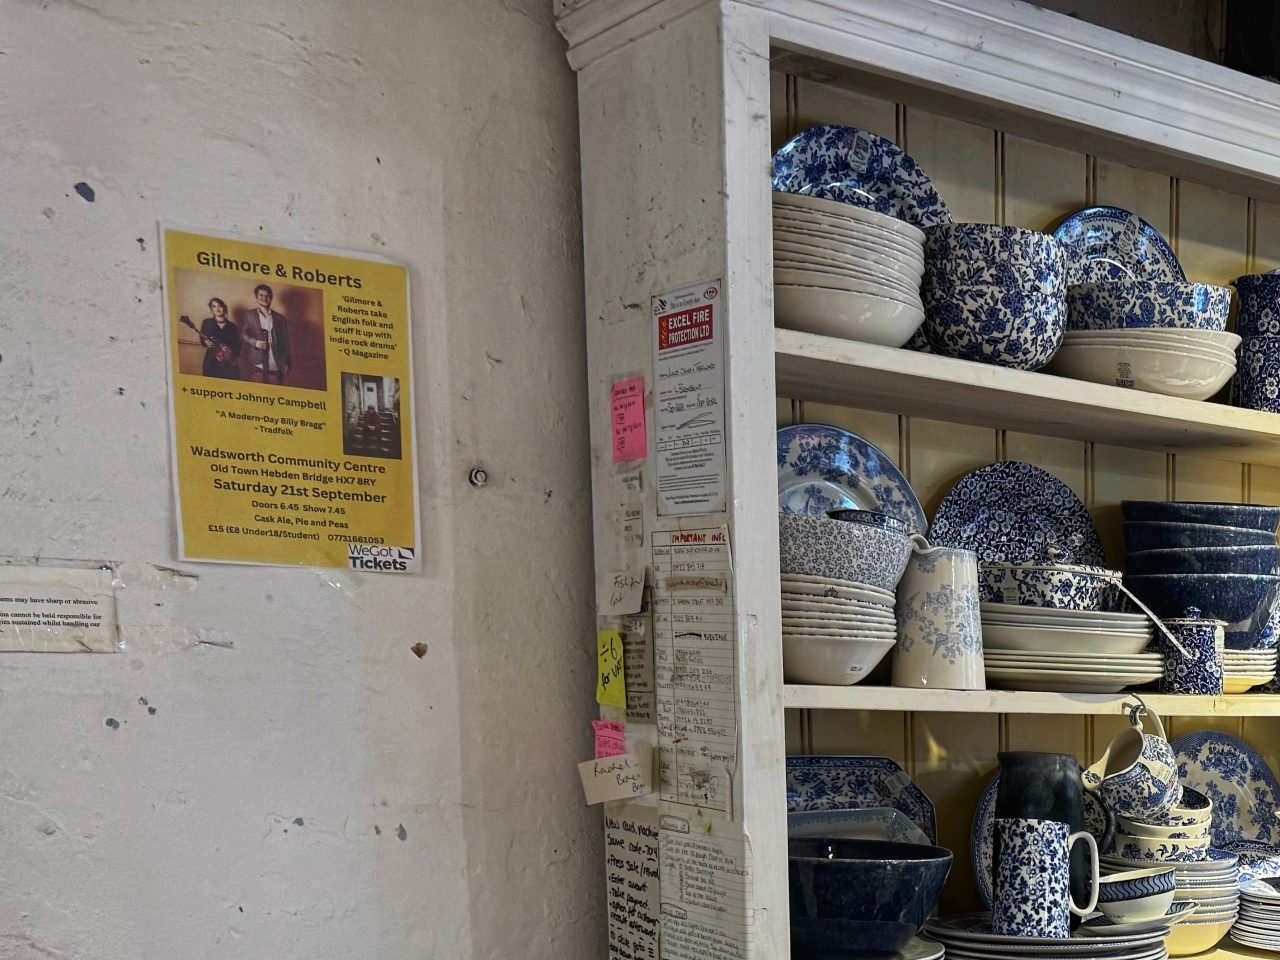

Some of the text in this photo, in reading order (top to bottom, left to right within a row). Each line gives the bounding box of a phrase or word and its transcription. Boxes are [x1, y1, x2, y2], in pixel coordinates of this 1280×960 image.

[197, 251, 362, 289] Gilmore & Roberts
[337, 305, 388, 318] Roberts take
[668, 309, 710, 329] EXCEL FIRE
[332, 315, 360, 325] English
[362, 319, 377, 327] folk
[330, 336, 350, 345] indie
[355, 328, 362, 336] it
[363, 331, 373, 339] up
[375, 332, 392, 340] with
[668, 324, 710, 345] PROTECTION LTD
[344, 348, 389, 360] Q Magazine
[190, 387, 233, 400] support
[236, 392, 275, 406] Johnny
[278, 397, 327, 410] Campbell
[228, 411, 279, 425] Modern-Day
[281, 417, 299, 428] Billy
[260, 425, 293, 436] Tradfolk
[190, 445, 386, 474] Wadsworth Community Centre
[211, 463, 229, 473] Old
[231, 465, 259, 476] Town
[261, 468, 300, 480] Hebden
[302, 472, 334, 485] Bridge
[336, 476, 355, 485] HX7
[213, 478, 387, 503] Saturday 21st September
[251, 500, 346, 515] Doors 6.45 Show 7.45
[254, 514, 349, 529] Cask Ale, Pie and Peas
[208, 524, 224, 533] £15
[242, 527, 320, 541] Under18/Student)
[672, 533, 706, 544] IMPORTANT
[349, 544, 393, 558] WeGot
[349, 556, 407, 572] Tickets
[15, 597, 28, 605] may
[46, 598, 63, 606] sharp
[57, 613, 92, 621] responsible
[62, 620, 90, 628] handling
